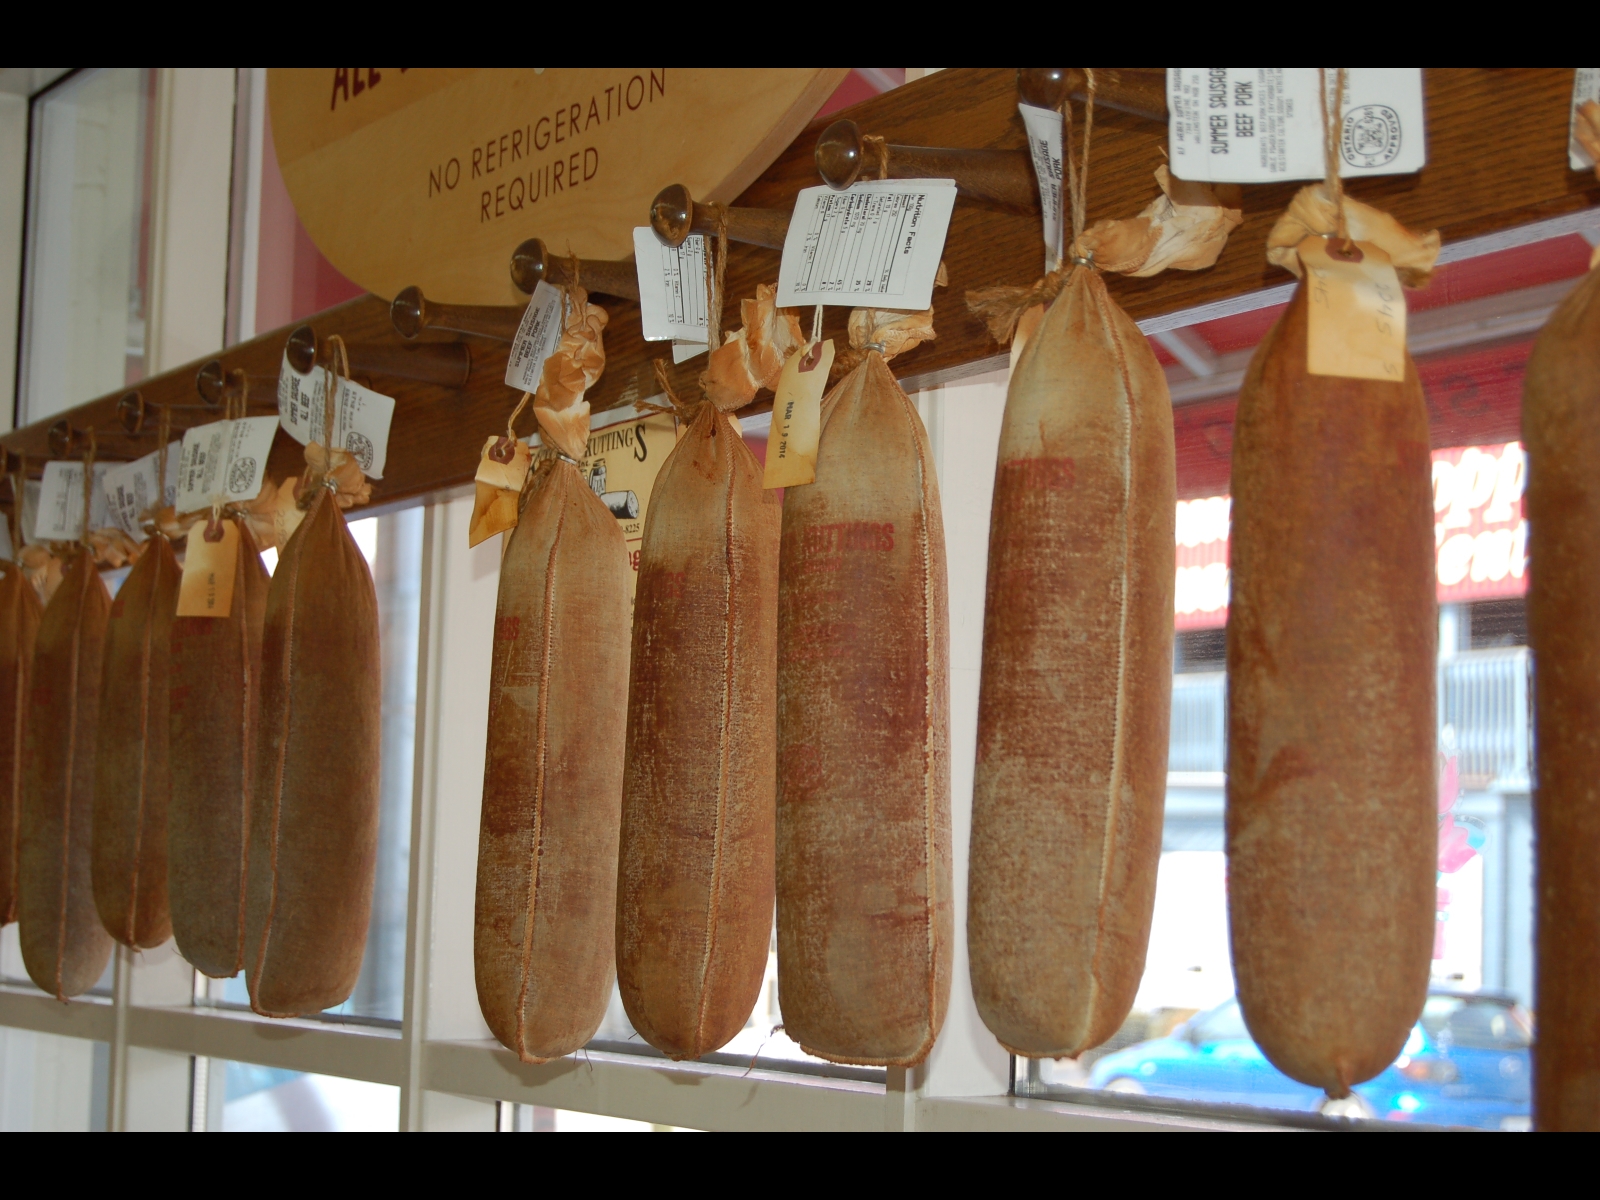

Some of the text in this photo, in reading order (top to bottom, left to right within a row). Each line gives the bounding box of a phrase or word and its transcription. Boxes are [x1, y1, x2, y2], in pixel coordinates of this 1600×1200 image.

[1234, 81, 1253, 138] BEEF PORK
[428, 68, 666, 198] NO REFRIGERATION
[1211, 113, 1228, 154] SUMMER
[1343, 117, 1355, 160] ONTARIO
[1380, 109, 1398, 160] APPROVED
[1039, 139, 1056, 180] SAUSAGE
[1051, 157, 1062, 181] PORK
[480, 147, 599, 223] REQUIRED
[826, 194, 835, 211] Protein
[855, 193, 864, 209] Sodium
[842, 193, 856, 225] Carbohydrate
[903, 194, 925, 254] Nutrition Facts
[514, 339, 528, 368] SUMMER
[525, 306, 541, 337] SAUSAGE
[523, 320, 541, 359] BEEF PORK
[784, 401, 795, 420] MAR
[778, 441, 787, 459] 2014
